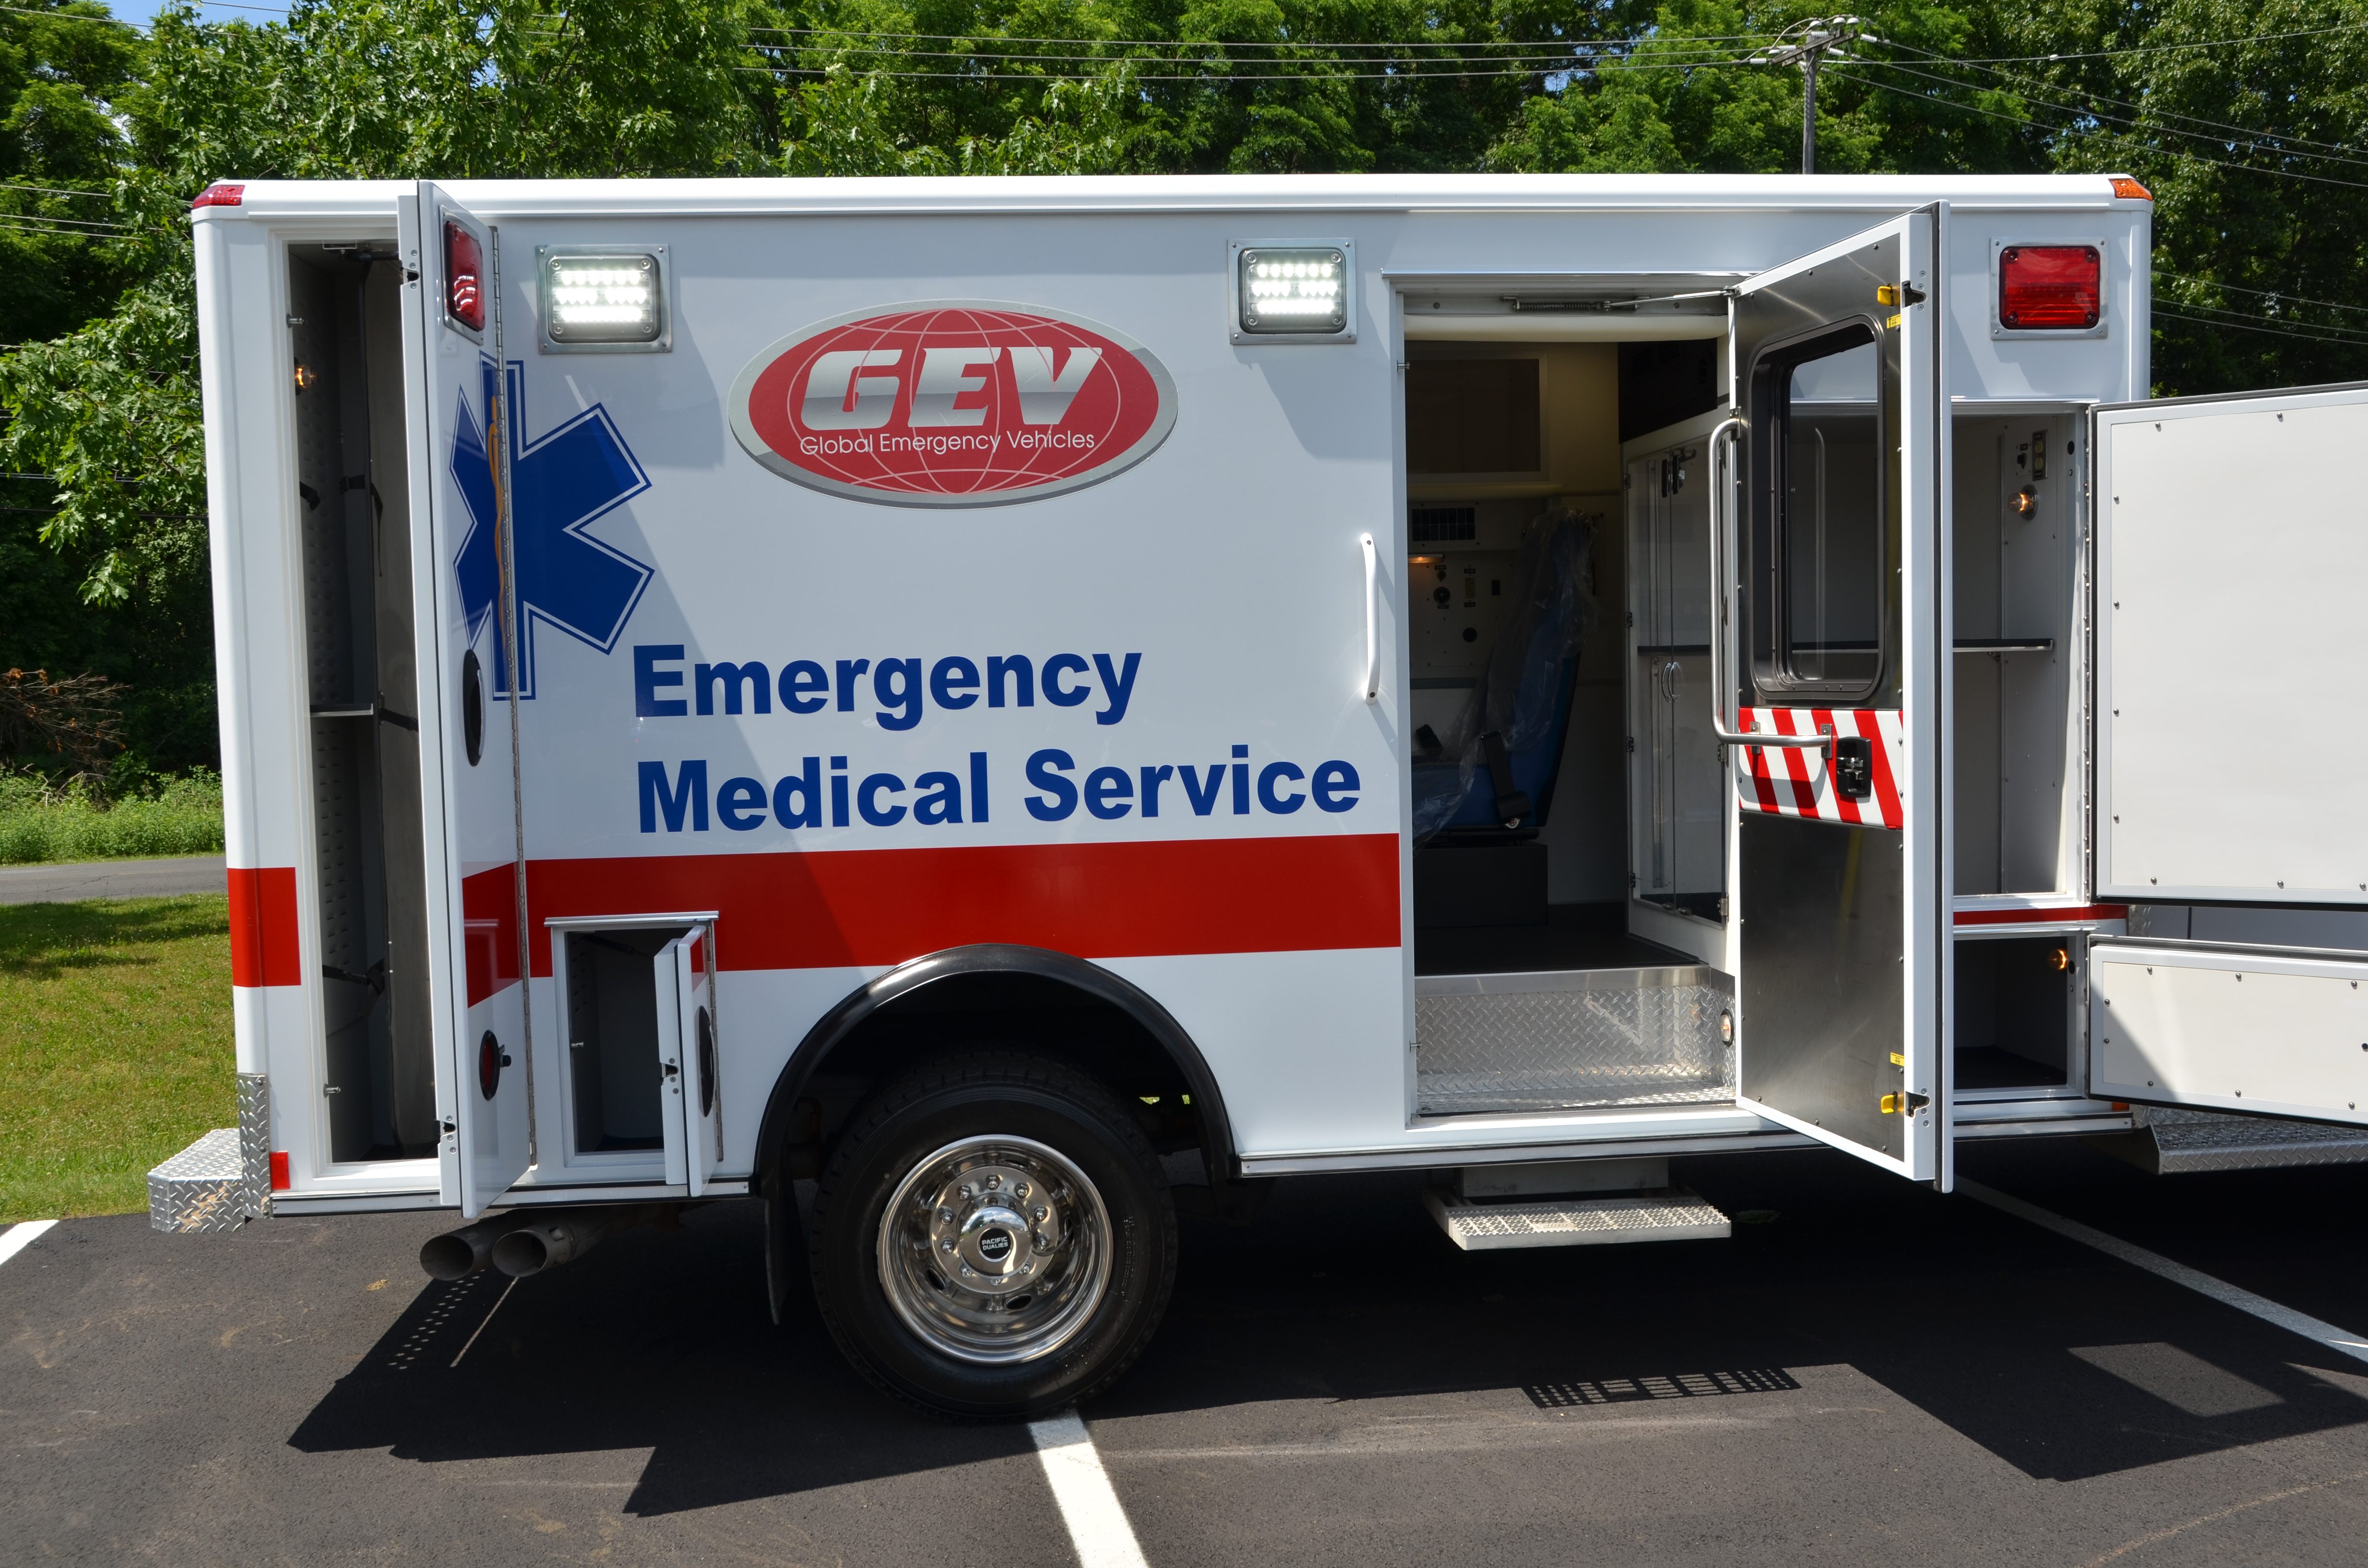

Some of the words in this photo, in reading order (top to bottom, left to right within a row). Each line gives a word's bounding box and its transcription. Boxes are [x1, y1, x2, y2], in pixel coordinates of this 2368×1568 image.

[801, 346, 1102, 430] GEV
[800, 435, 873, 454] Global
[880, 433, 1001, 454] Emergency
[1007, 430, 1095, 449] Vehicles
[634, 645, 1142, 731] Emergency
[638, 752, 989, 833] Medical
[1024, 745, 1360, 821] Service
[982, 1237, 1007, 1245] PACIFIC
[983, 1242, 1008, 1250] DUALIES
